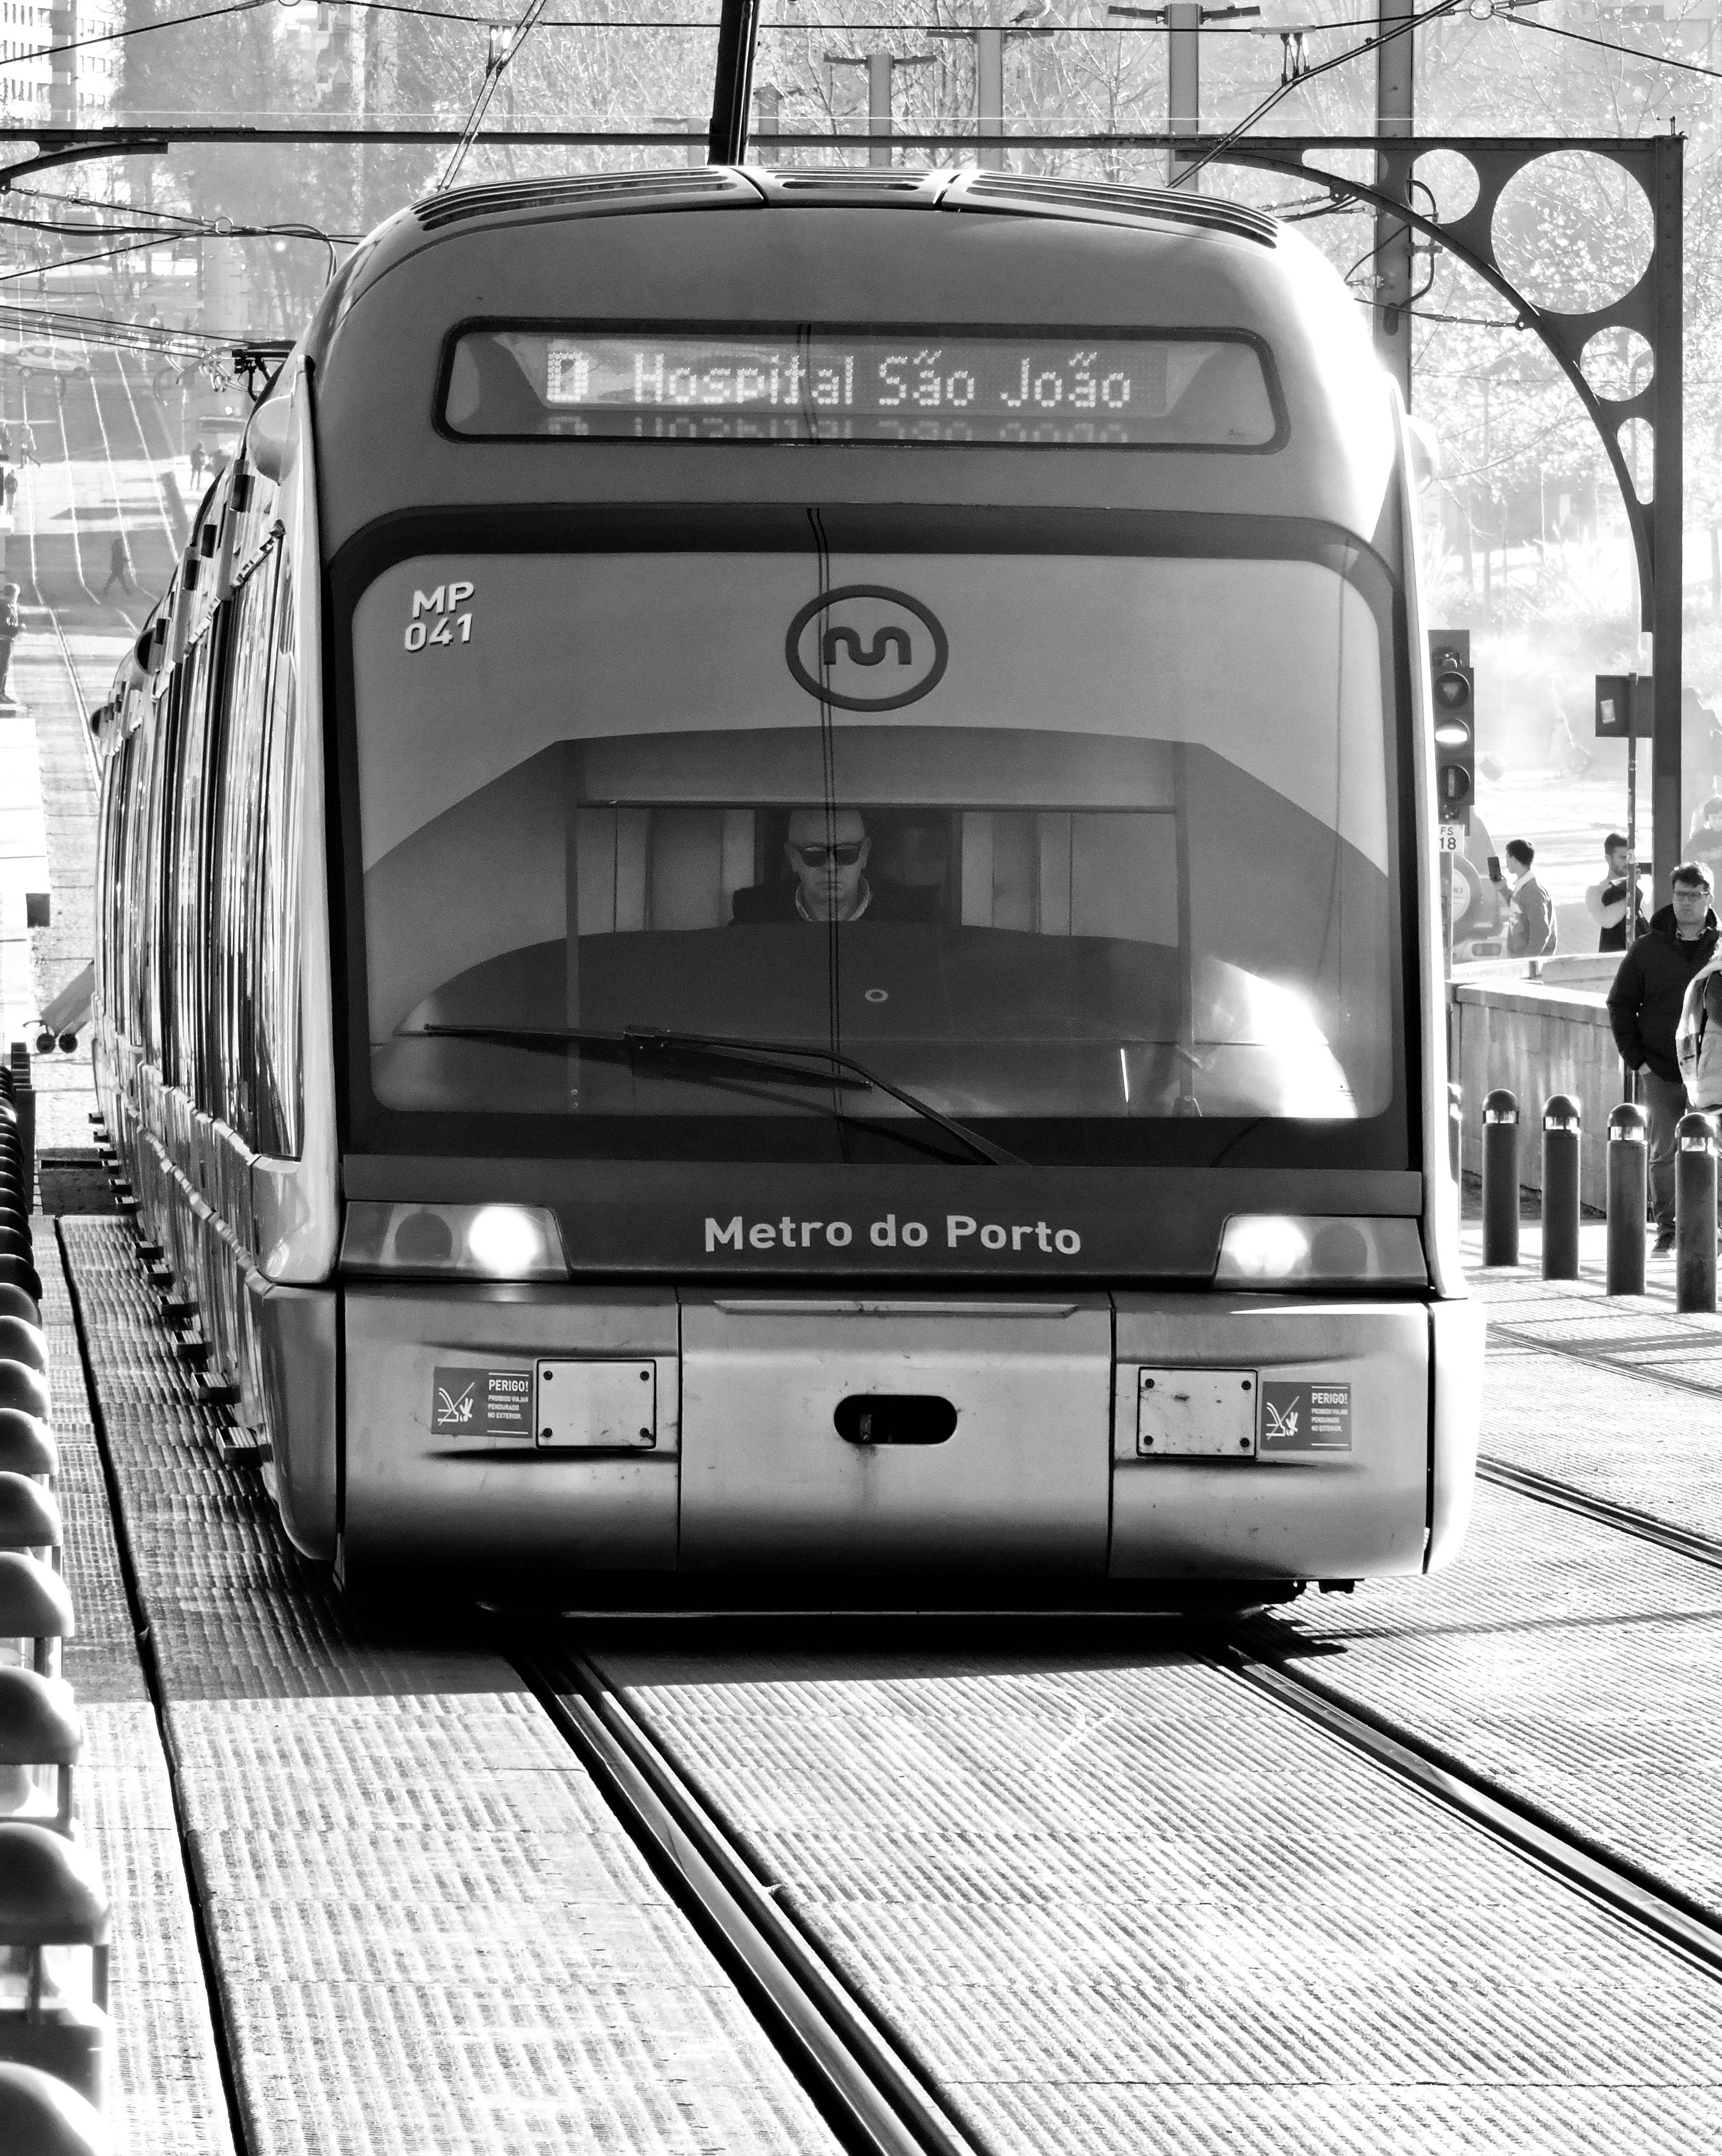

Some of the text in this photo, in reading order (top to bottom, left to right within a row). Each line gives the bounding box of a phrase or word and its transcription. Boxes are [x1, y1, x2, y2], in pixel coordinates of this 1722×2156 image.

[635, 353, 854, 404] Hospital
[879, 350, 974, 406] São
[1000, 352, 1130, 408] João
[412, 582, 475, 620] MP
[404, 613, 472, 652] 041
[1439, 837, 1456, 850] 18
[1441, 827, 1454, 836] FS
[705, 1214, 1081, 1254] Metro do Porto
[488, 1379, 528, 1392] PERIGO!
[1311, 1393, 1348, 1404] PERIGO!
